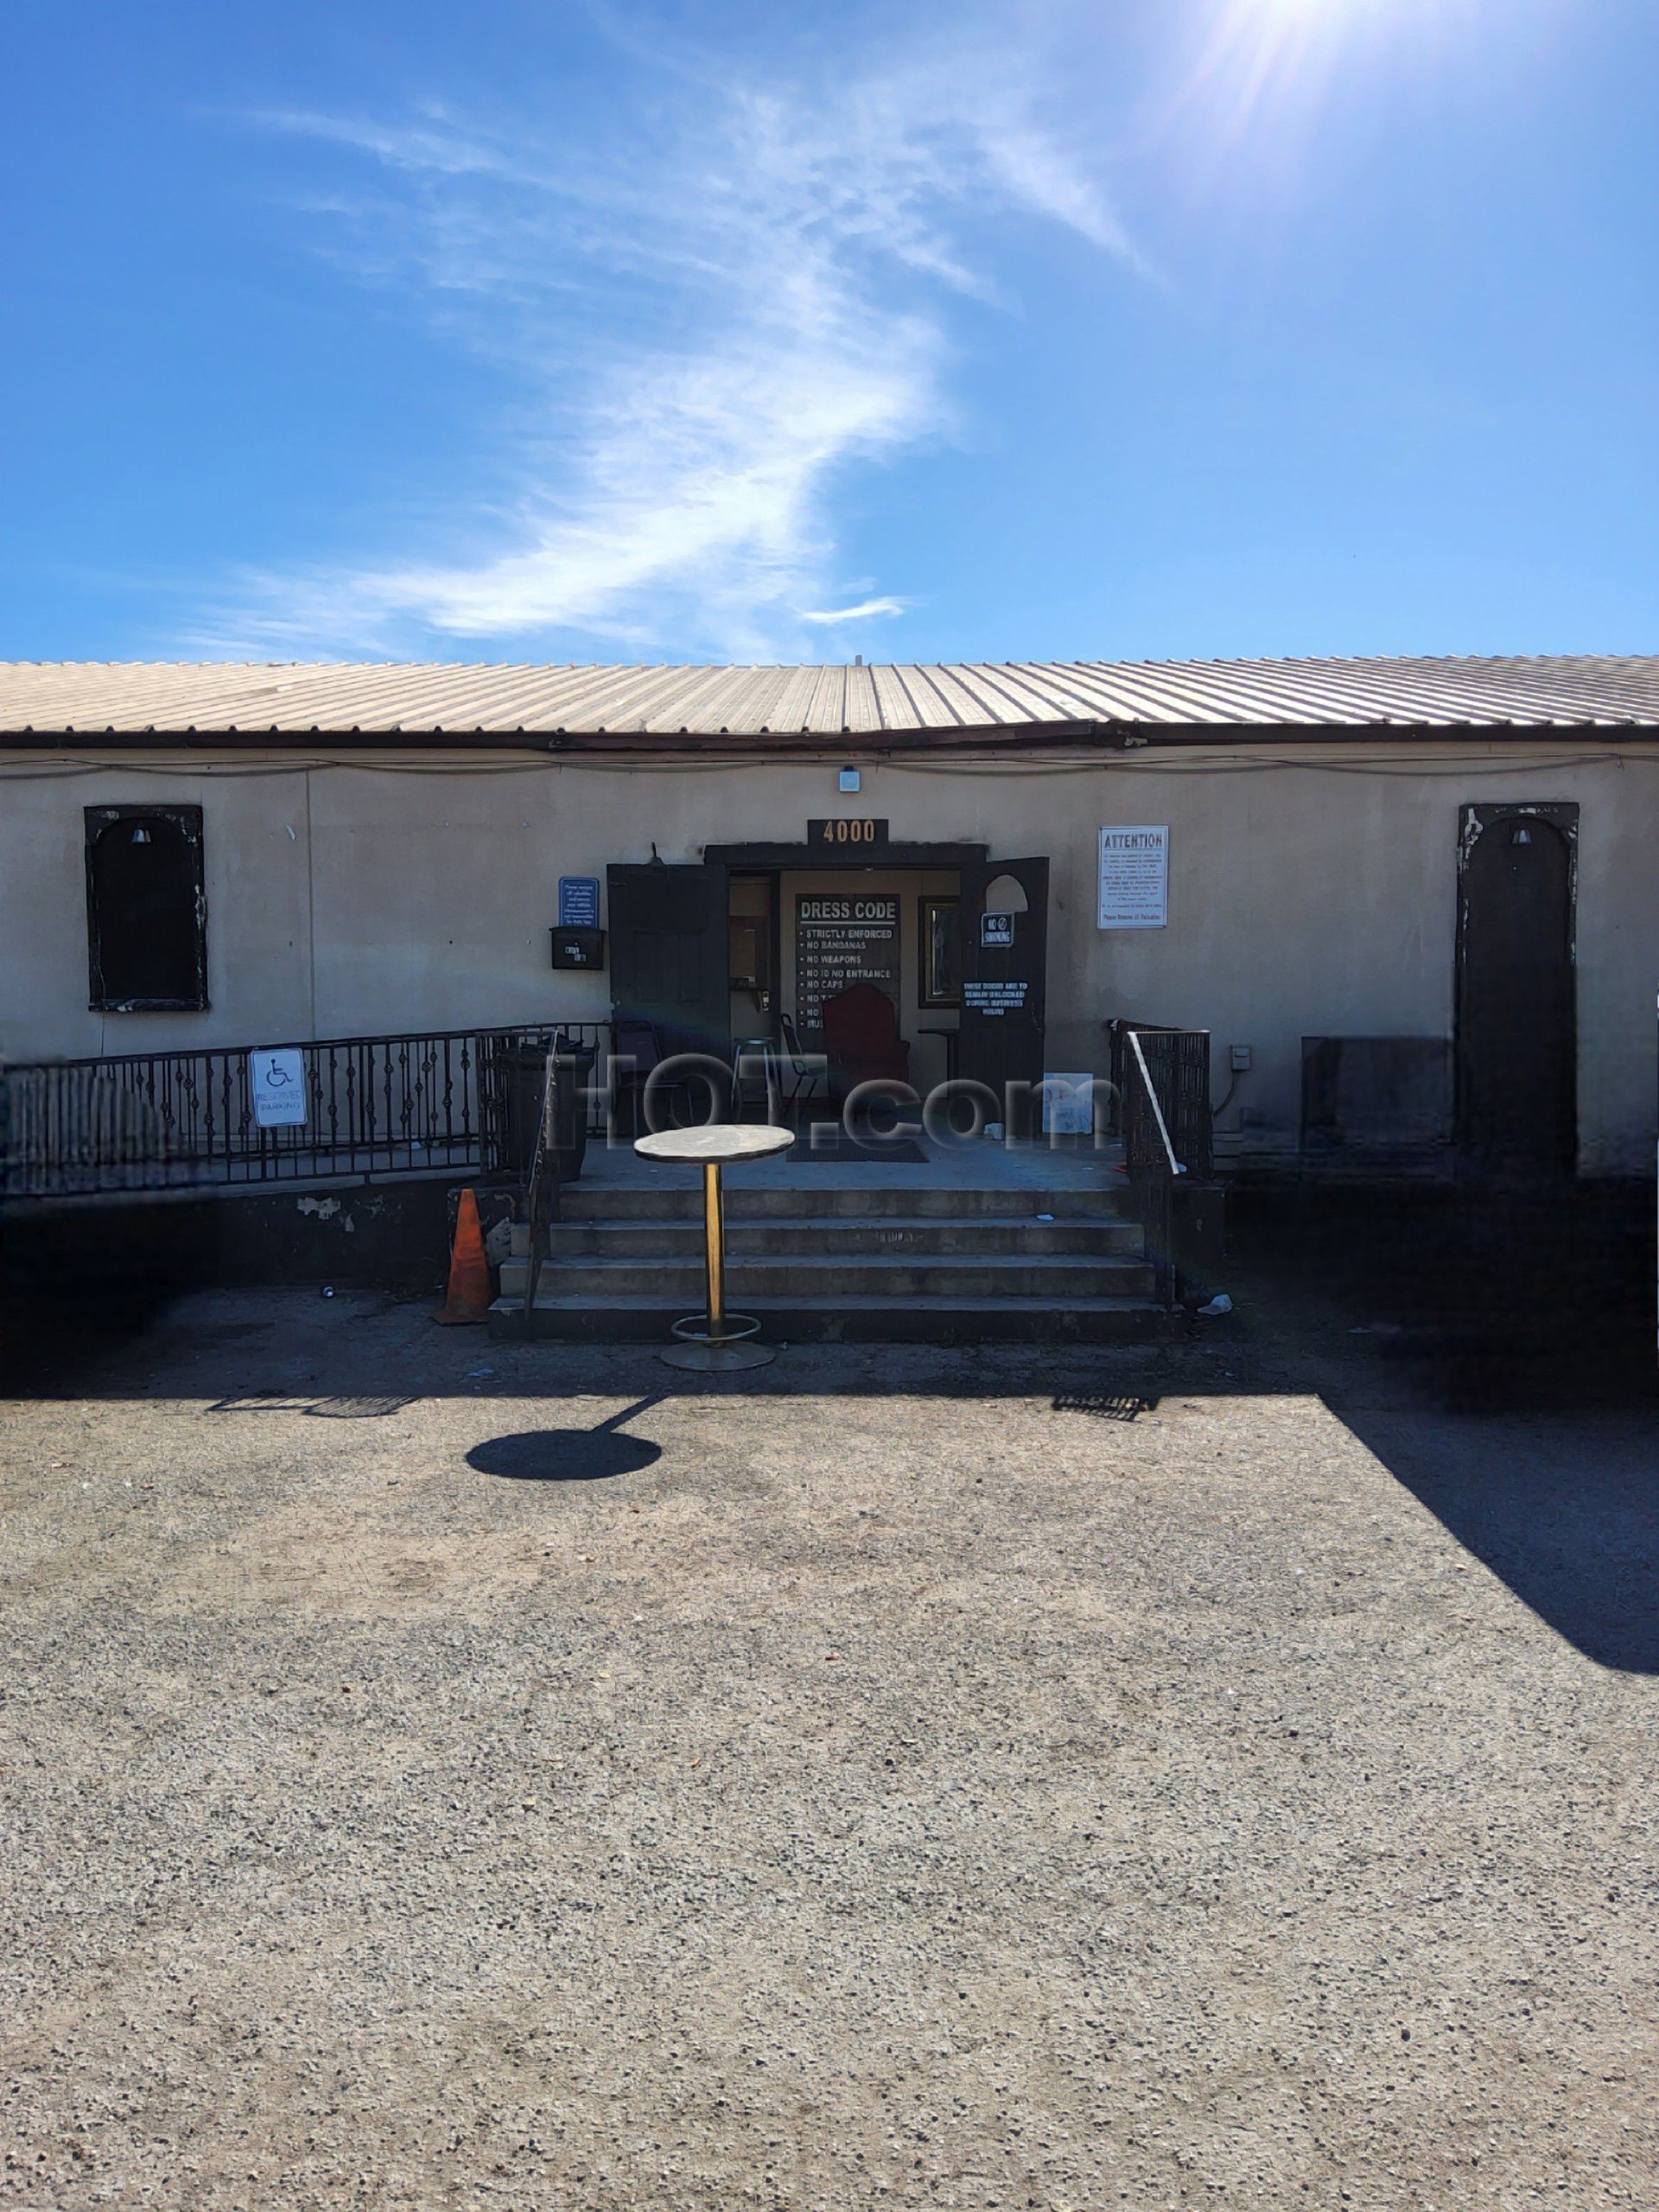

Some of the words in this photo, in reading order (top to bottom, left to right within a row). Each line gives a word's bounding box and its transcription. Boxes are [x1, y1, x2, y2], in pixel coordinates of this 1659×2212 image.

[823, 820, 874, 842] 4000
[1104, 833, 1162, 849] ATTENTION
[801, 901, 850, 918] DRESS
[855, 901, 896, 918] CODE
[988, 918, 996, 931] NO
[806, 929, 845, 938] STRICTLY
[848, 929, 893, 938] ENFORCED
[806, 941, 819, 950] NO
[821, 941, 867, 950] BANDANAS
[806, 955, 819, 963] NO
[821, 955, 862, 963] WEAPONS
[806, 969, 818, 978] NO
[821, 969, 830, 978] ID
[831, 969, 844, 978] NO
[846, 969, 892, 978] ENTRANCE
[806, 980, 819, 989] NO
[821, 980, 843, 989] CAPS
[806, 995, 819, 1003] NO
[806, 1008, 819, 1017] NO
[261, 1102, 301, 1112] PARKING
